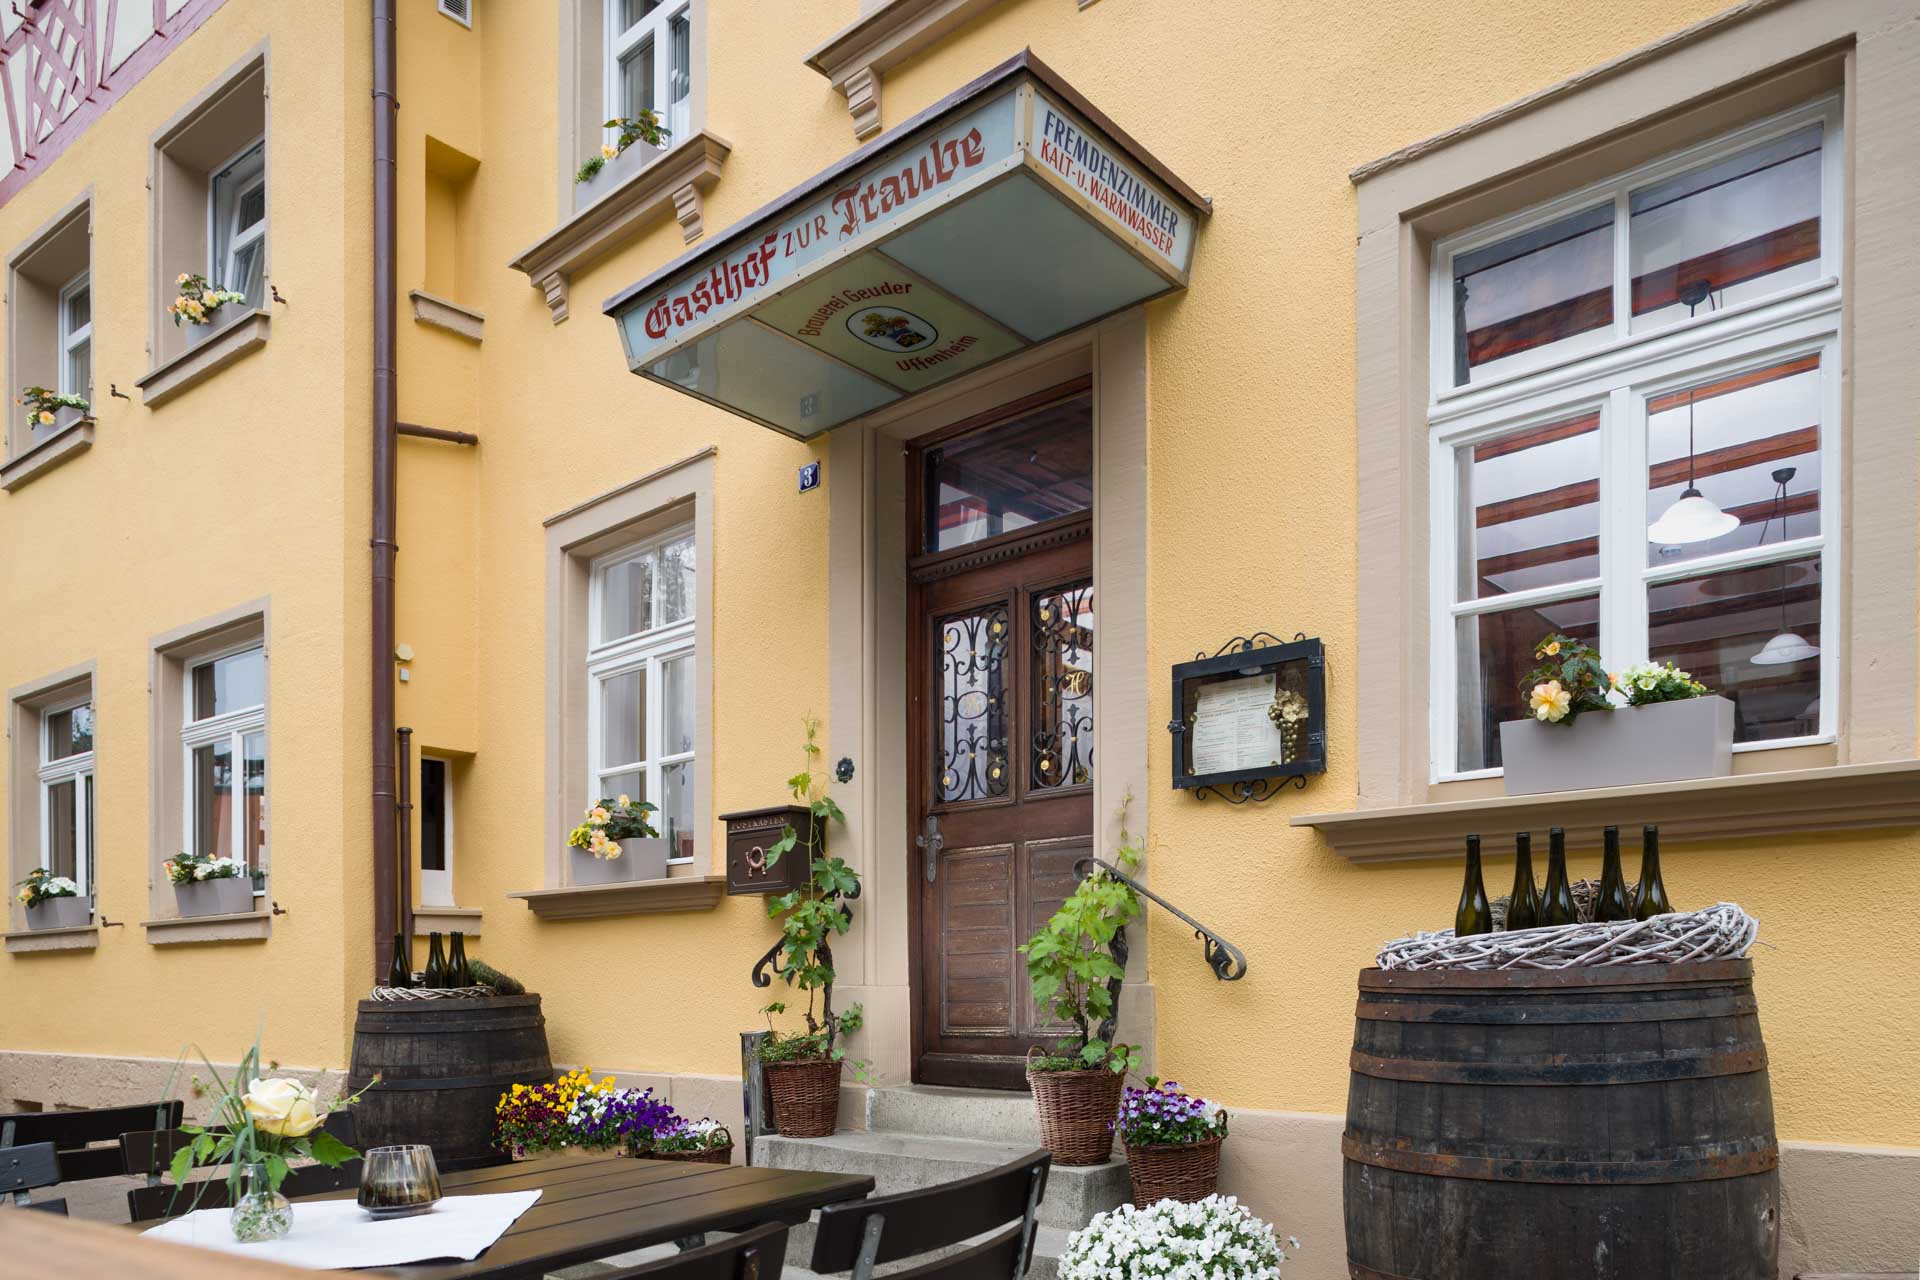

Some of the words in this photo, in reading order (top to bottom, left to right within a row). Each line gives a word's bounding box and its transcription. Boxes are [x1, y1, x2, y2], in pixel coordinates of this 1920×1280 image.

[1043, 110, 1178, 238] FREMDENZIMMER
[644, 231, 778, 340] Gasthof
[781, 214, 829, 258] ZUR
[831, 127, 985, 242] Traube
[798, 296, 849, 337] Brauerei
[842, 282, 913, 302] Geuder
[896, 335, 978, 371] Uffenheim
[804, 467, 813, 486] 3
[731, 815, 785, 830] POSTKASTEN
